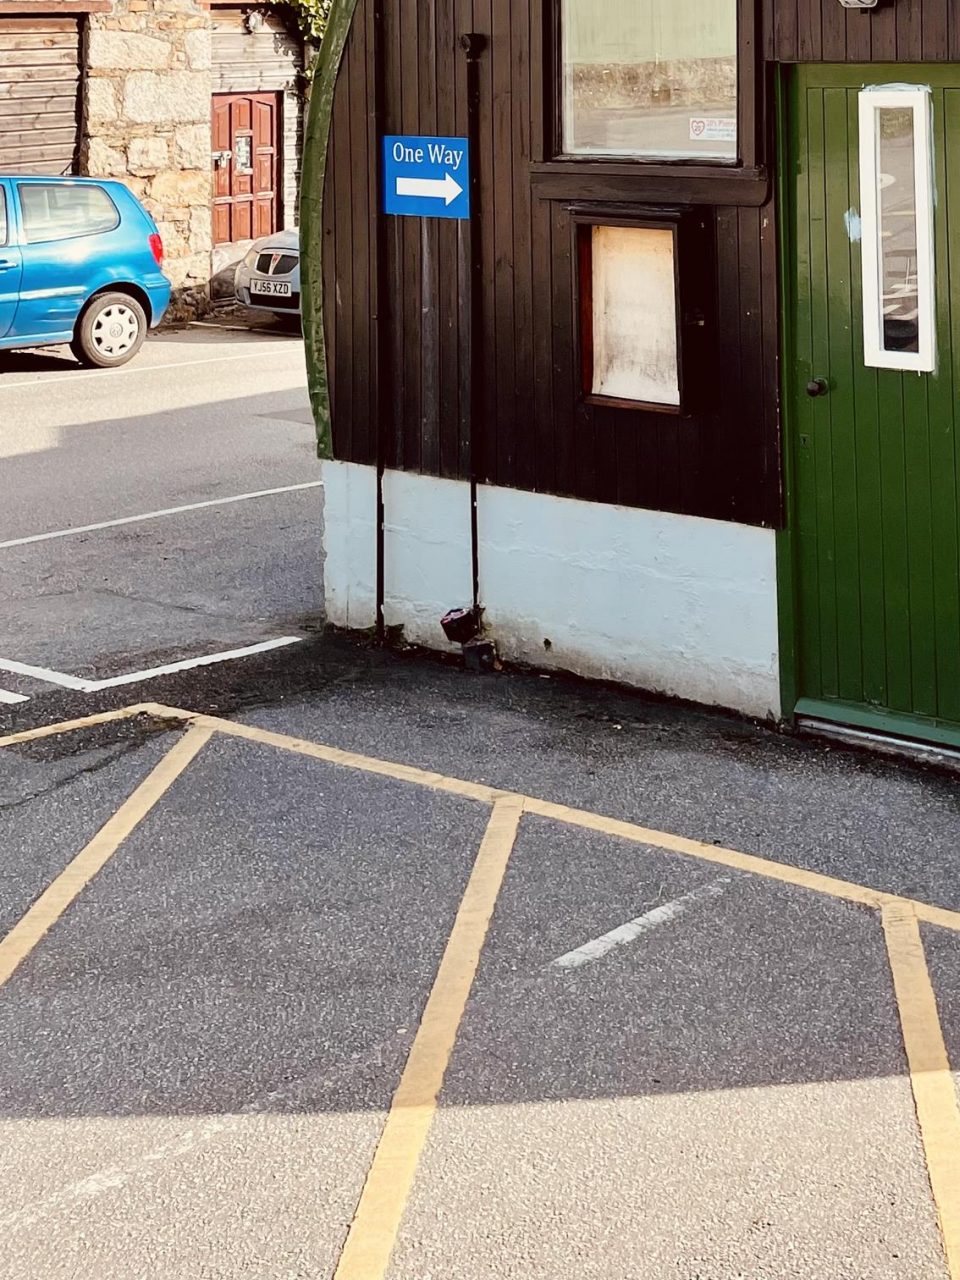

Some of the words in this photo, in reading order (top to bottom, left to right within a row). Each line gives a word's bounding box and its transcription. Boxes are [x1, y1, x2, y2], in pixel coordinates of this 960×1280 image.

[393, 142, 424, 163] One
[427, 144, 464, 170] Way
[253, 281, 272, 293] YJ56
